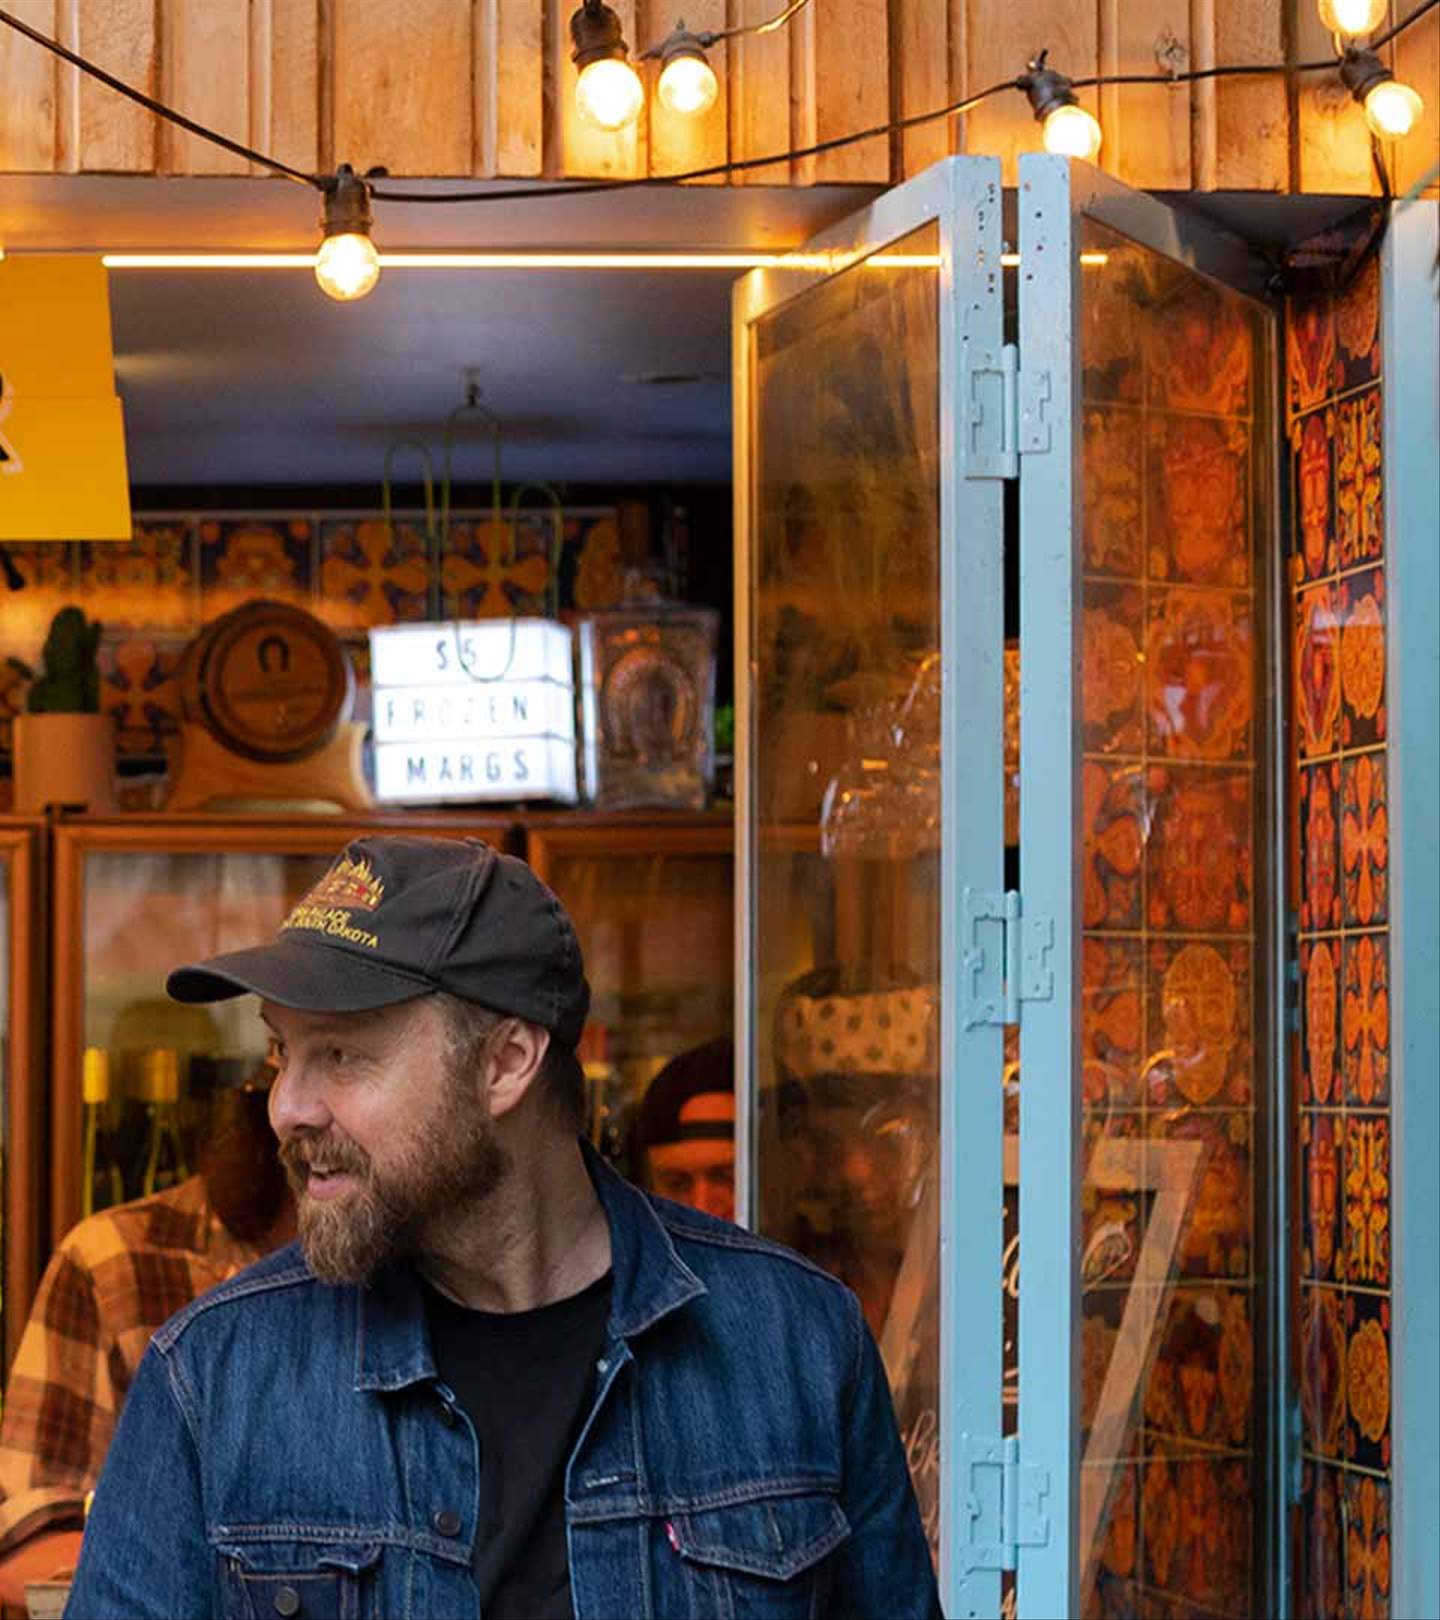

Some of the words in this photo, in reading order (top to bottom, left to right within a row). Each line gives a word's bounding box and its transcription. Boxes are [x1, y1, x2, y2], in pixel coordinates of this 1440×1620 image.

[386, 695, 529, 728] FROZEN
[406, 750, 530, 784] MARGS
[326, 920, 378, 948] DAKOTA
